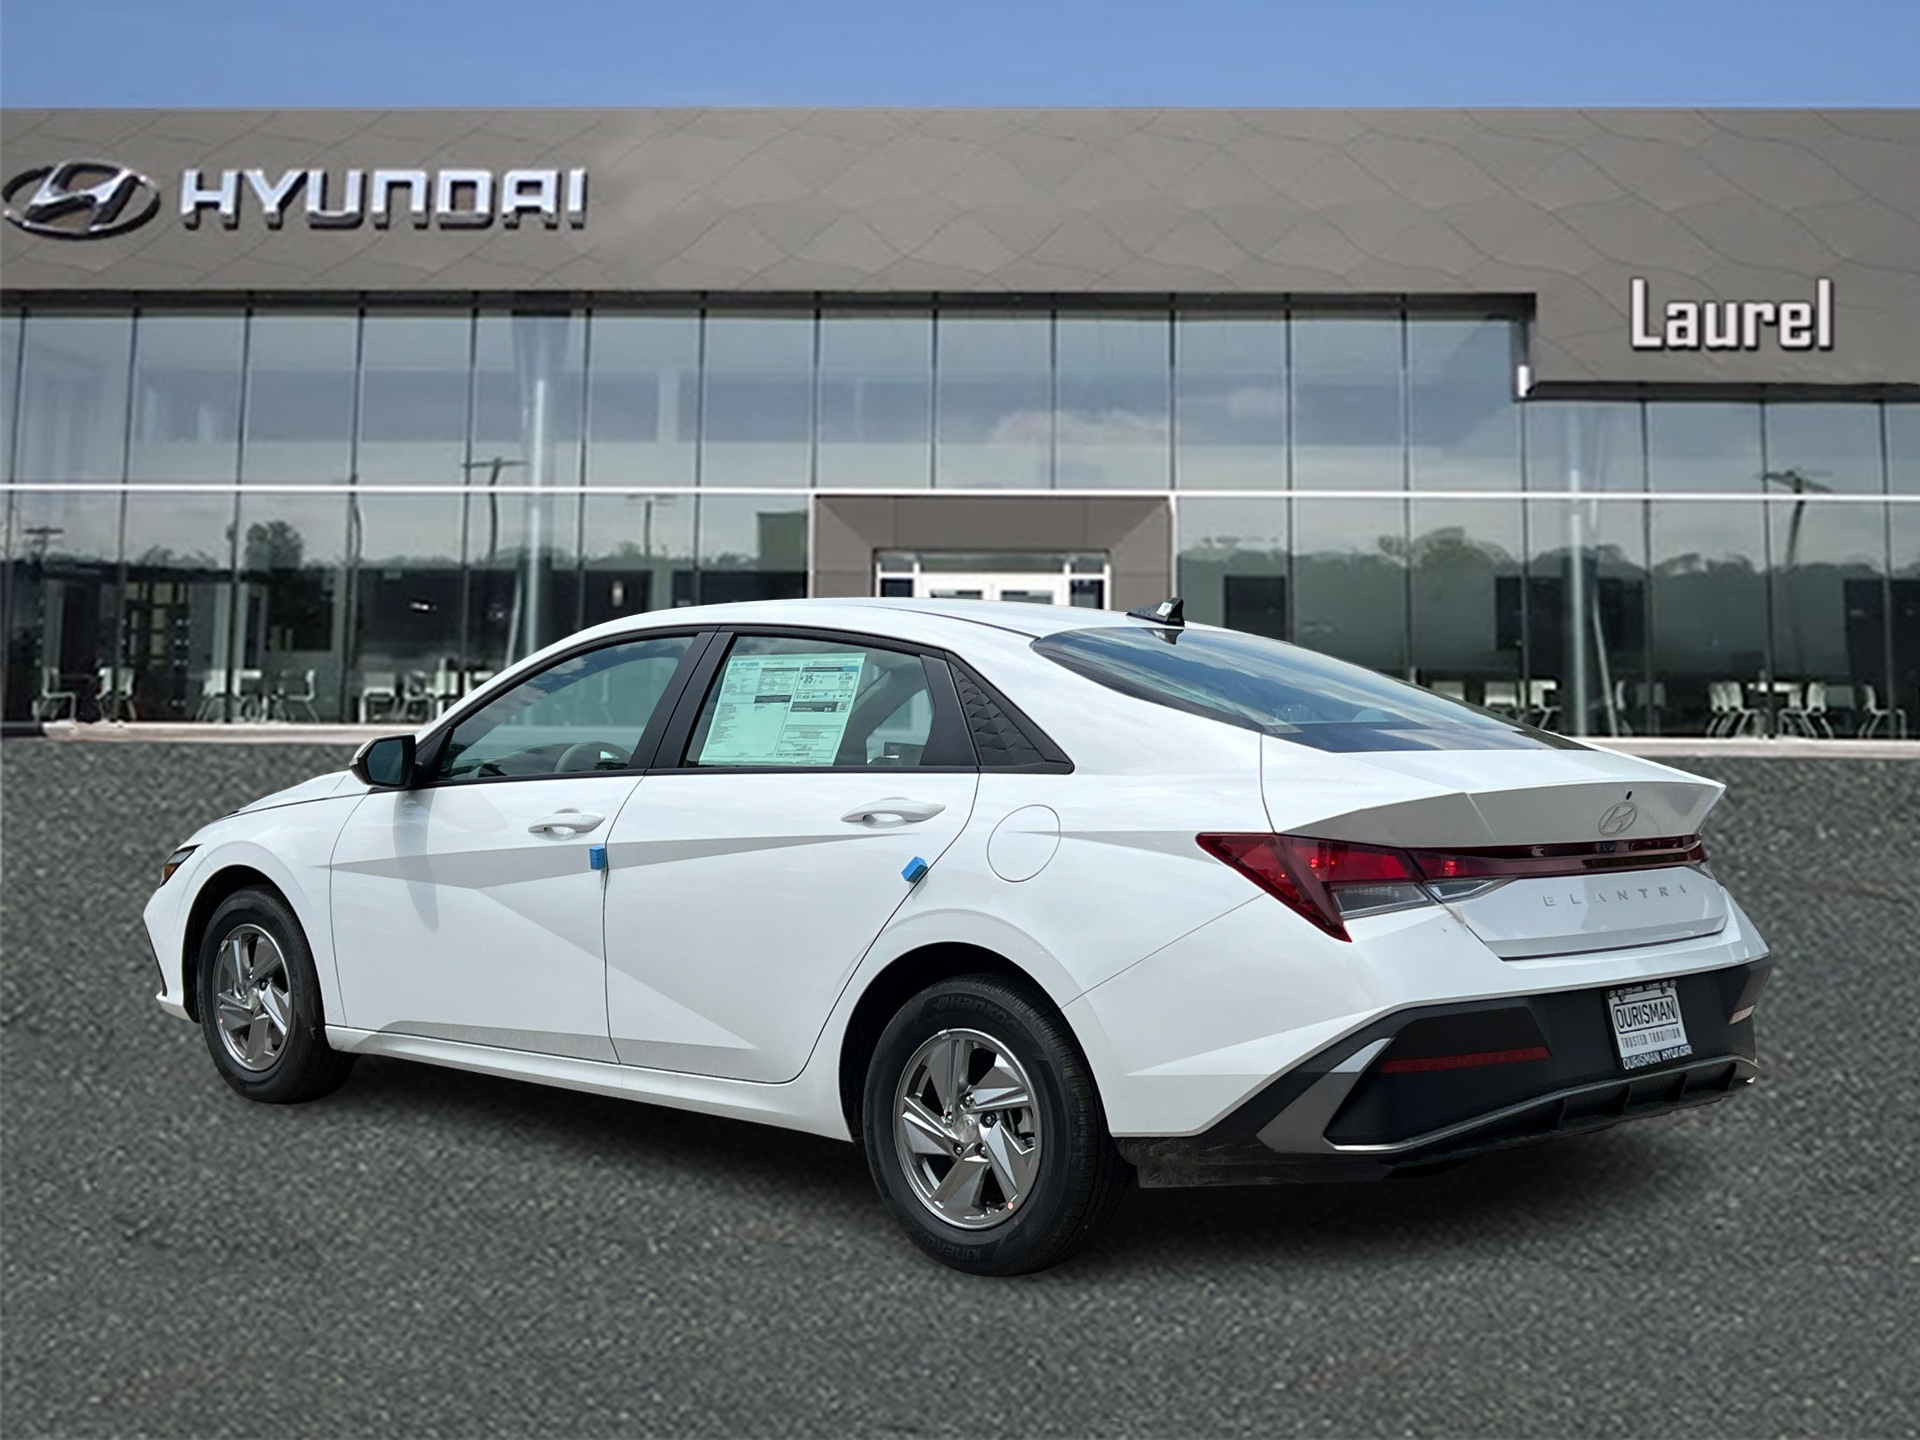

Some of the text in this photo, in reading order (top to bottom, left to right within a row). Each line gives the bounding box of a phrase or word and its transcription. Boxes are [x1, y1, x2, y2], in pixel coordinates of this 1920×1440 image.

[180, 168, 588, 230] HYUNDAI
[1631, 278, 1833, 349] Laurel
[803, 674, 813, 684] 35
[1543, 884, 1687, 907] ELANTRA
[1615, 1001, 1676, 1029] OURISMAN
[1621, 1027, 1682, 1049] TRUSTED TRADITION
[1623, 1050, 1661, 1070] OURISMAN
